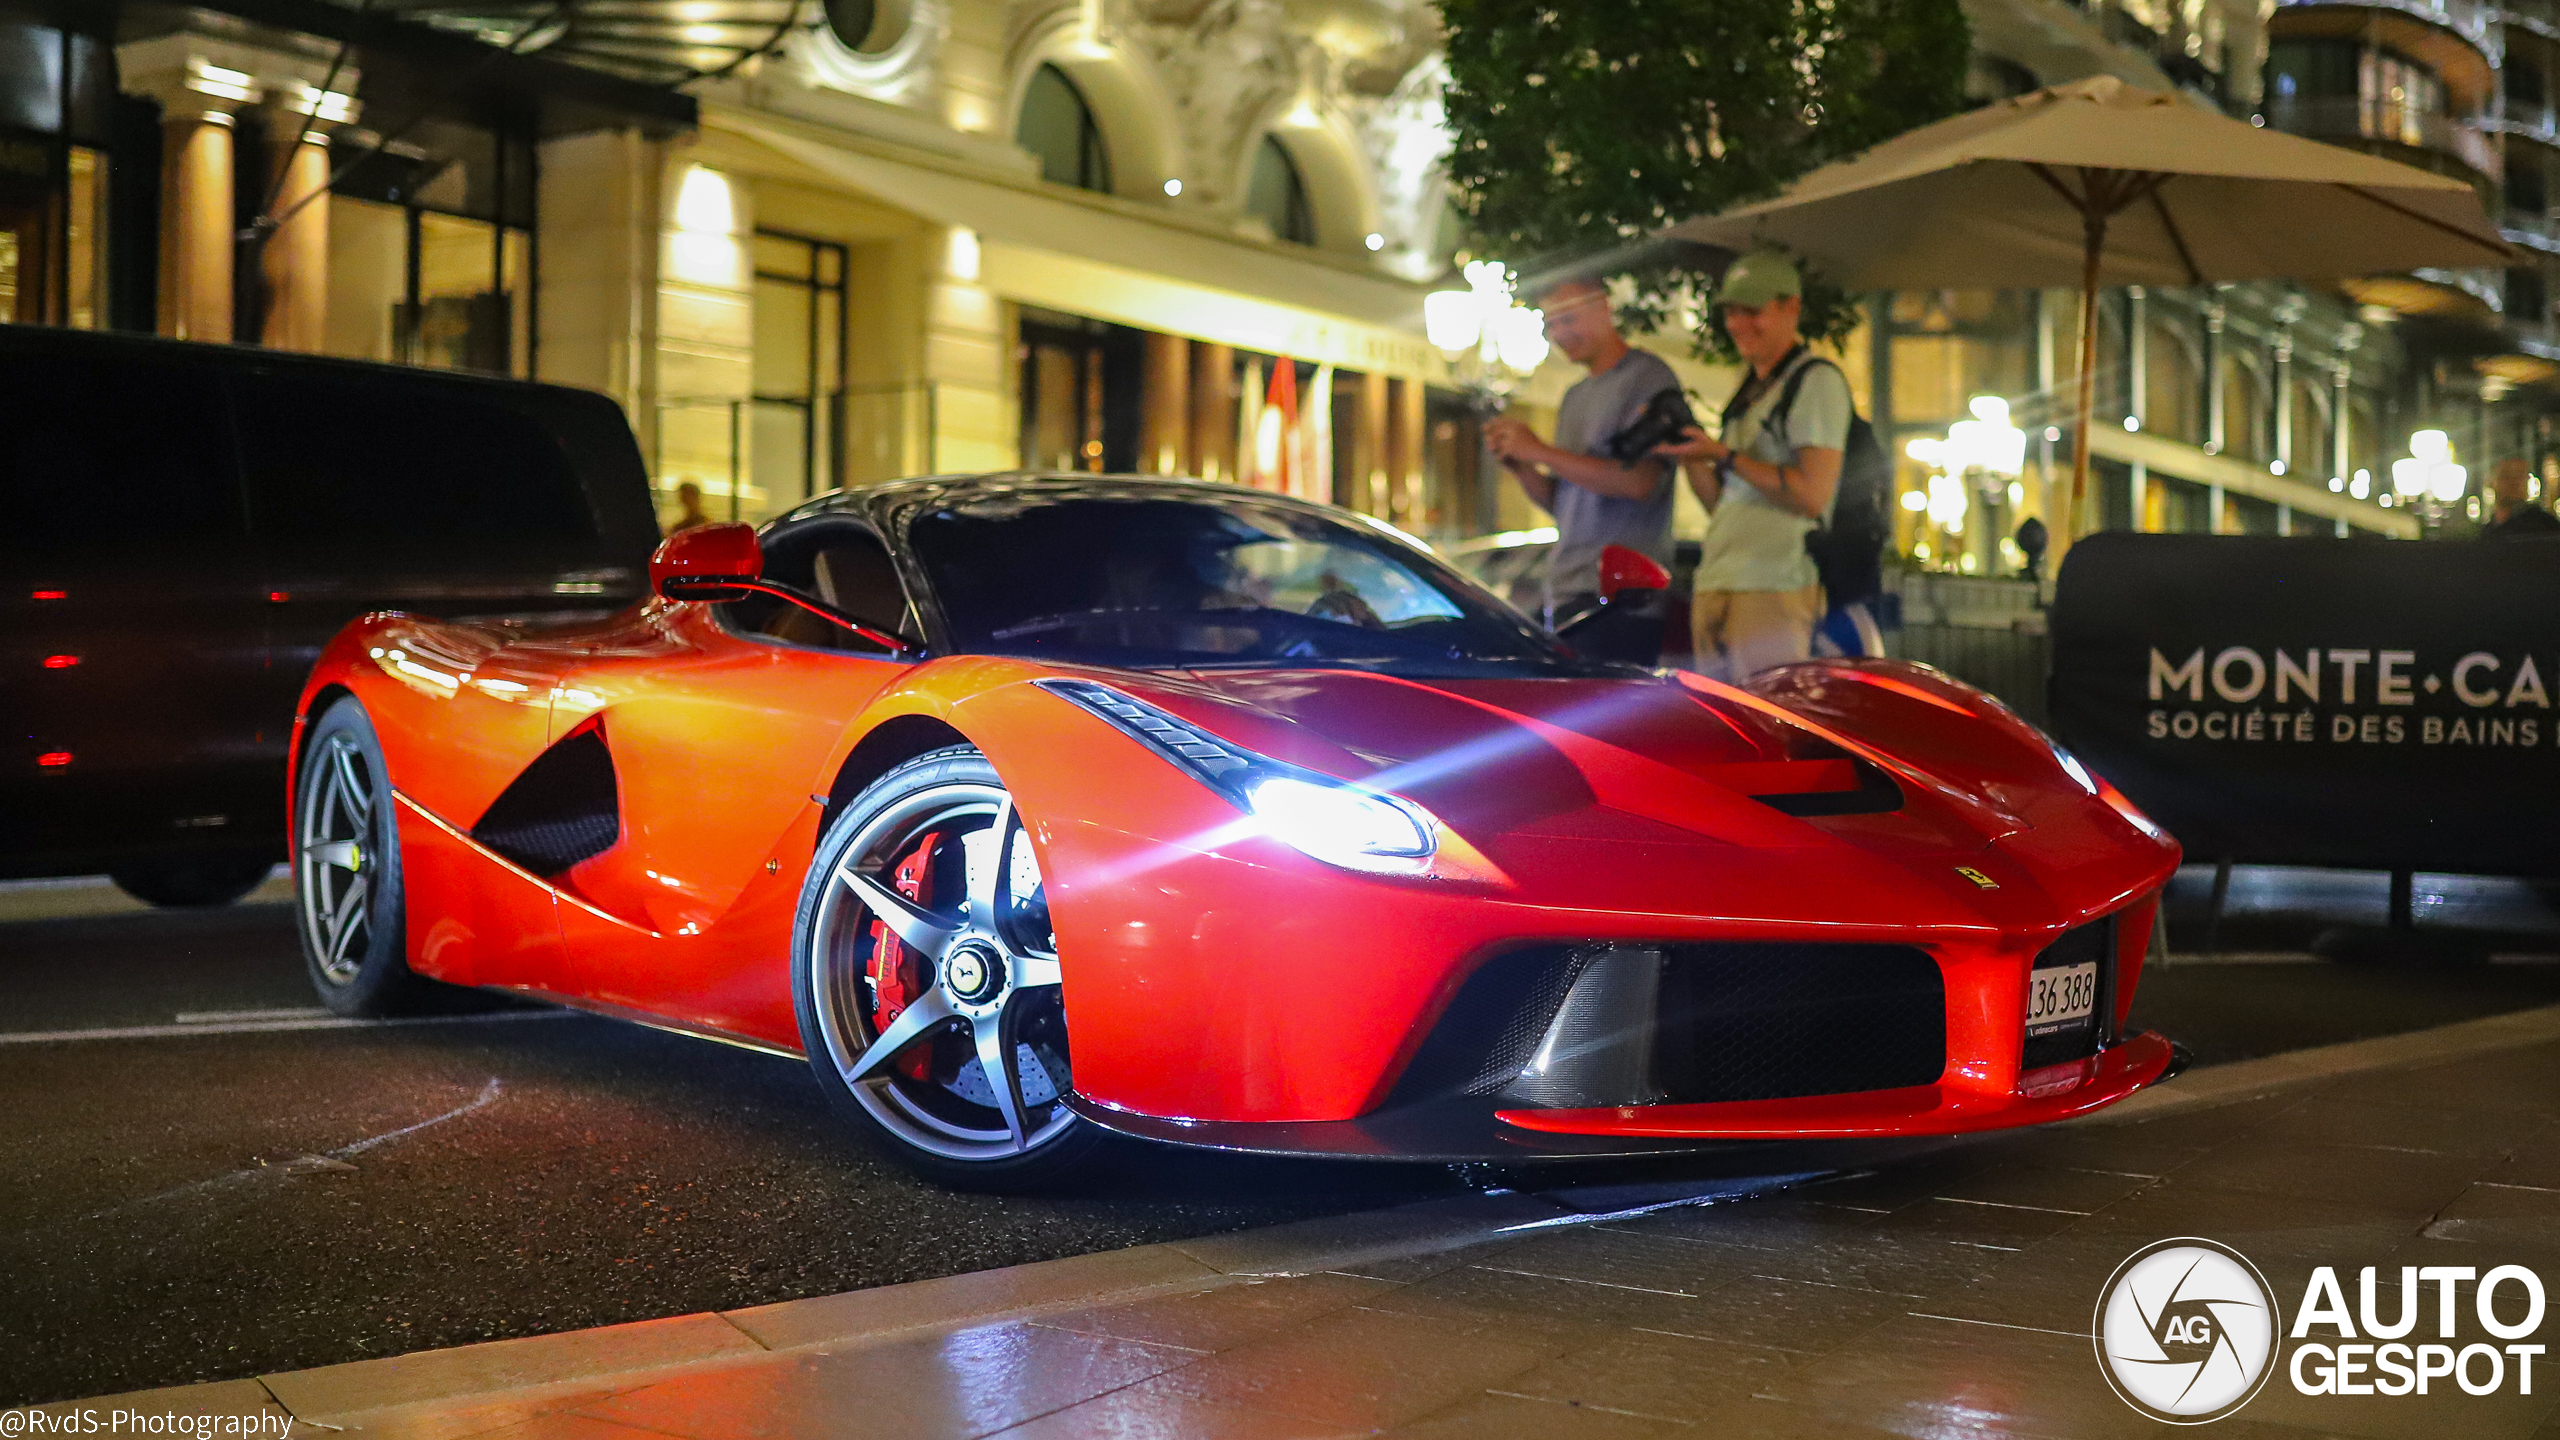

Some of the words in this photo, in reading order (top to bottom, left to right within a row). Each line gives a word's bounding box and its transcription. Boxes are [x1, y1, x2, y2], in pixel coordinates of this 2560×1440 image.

[2148, 708, 2315, 742] SOCIÉTÉ
[2332, 715, 2405, 743] DES
[2423, 717, 2539, 746] BAINS
[2060, 972, 2092, 1013] 388
